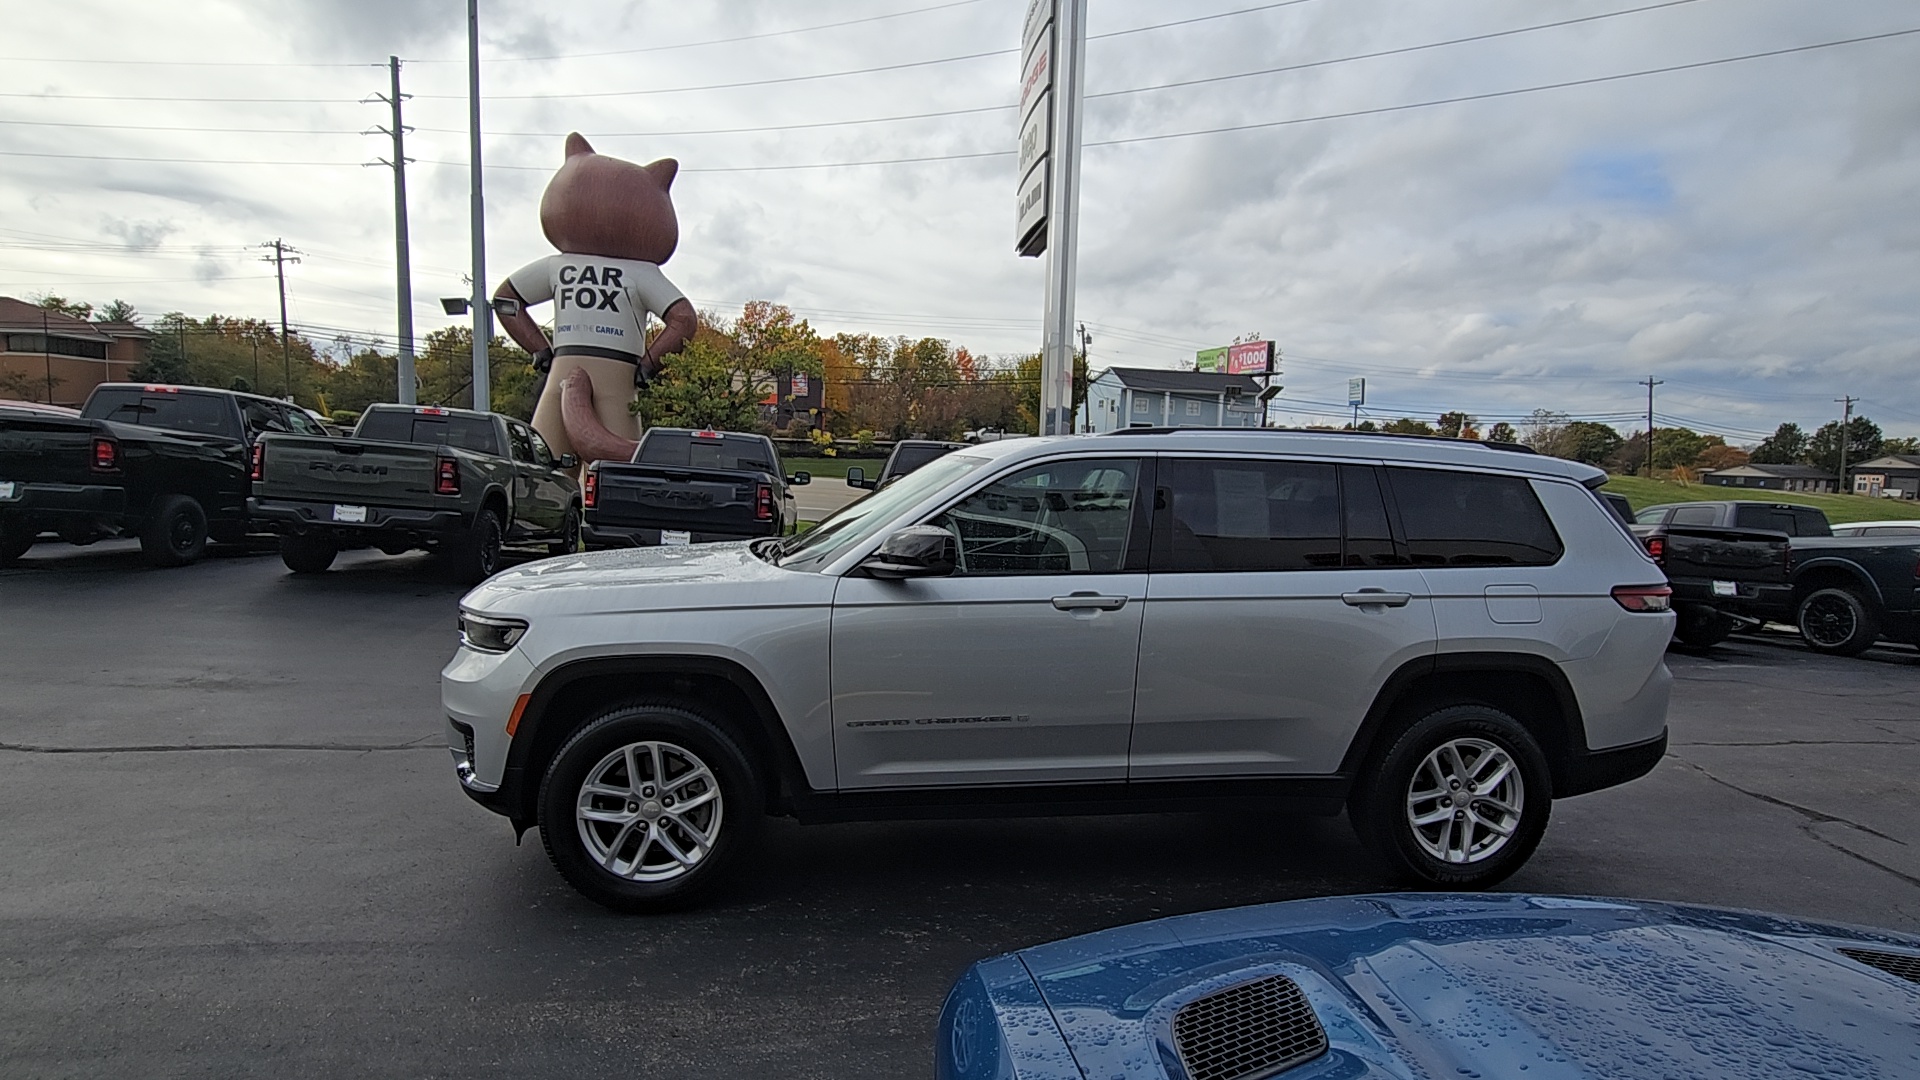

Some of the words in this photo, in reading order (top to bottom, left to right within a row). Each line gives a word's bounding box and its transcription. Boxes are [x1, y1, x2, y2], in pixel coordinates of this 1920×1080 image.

[559, 265, 623, 288] CAR
[560, 287, 620, 313] FOX
[557, 325, 571, 334] SHOW
[595, 325, 624, 337] CARFAX
[1239, 350, 1265, 365] $1000
[308, 461, 388, 476] RAM
[641, 489, 715, 502] RAM
[846, 719, 910, 727] GRAND
[915, 716, 1012, 725] CHEROKEE
